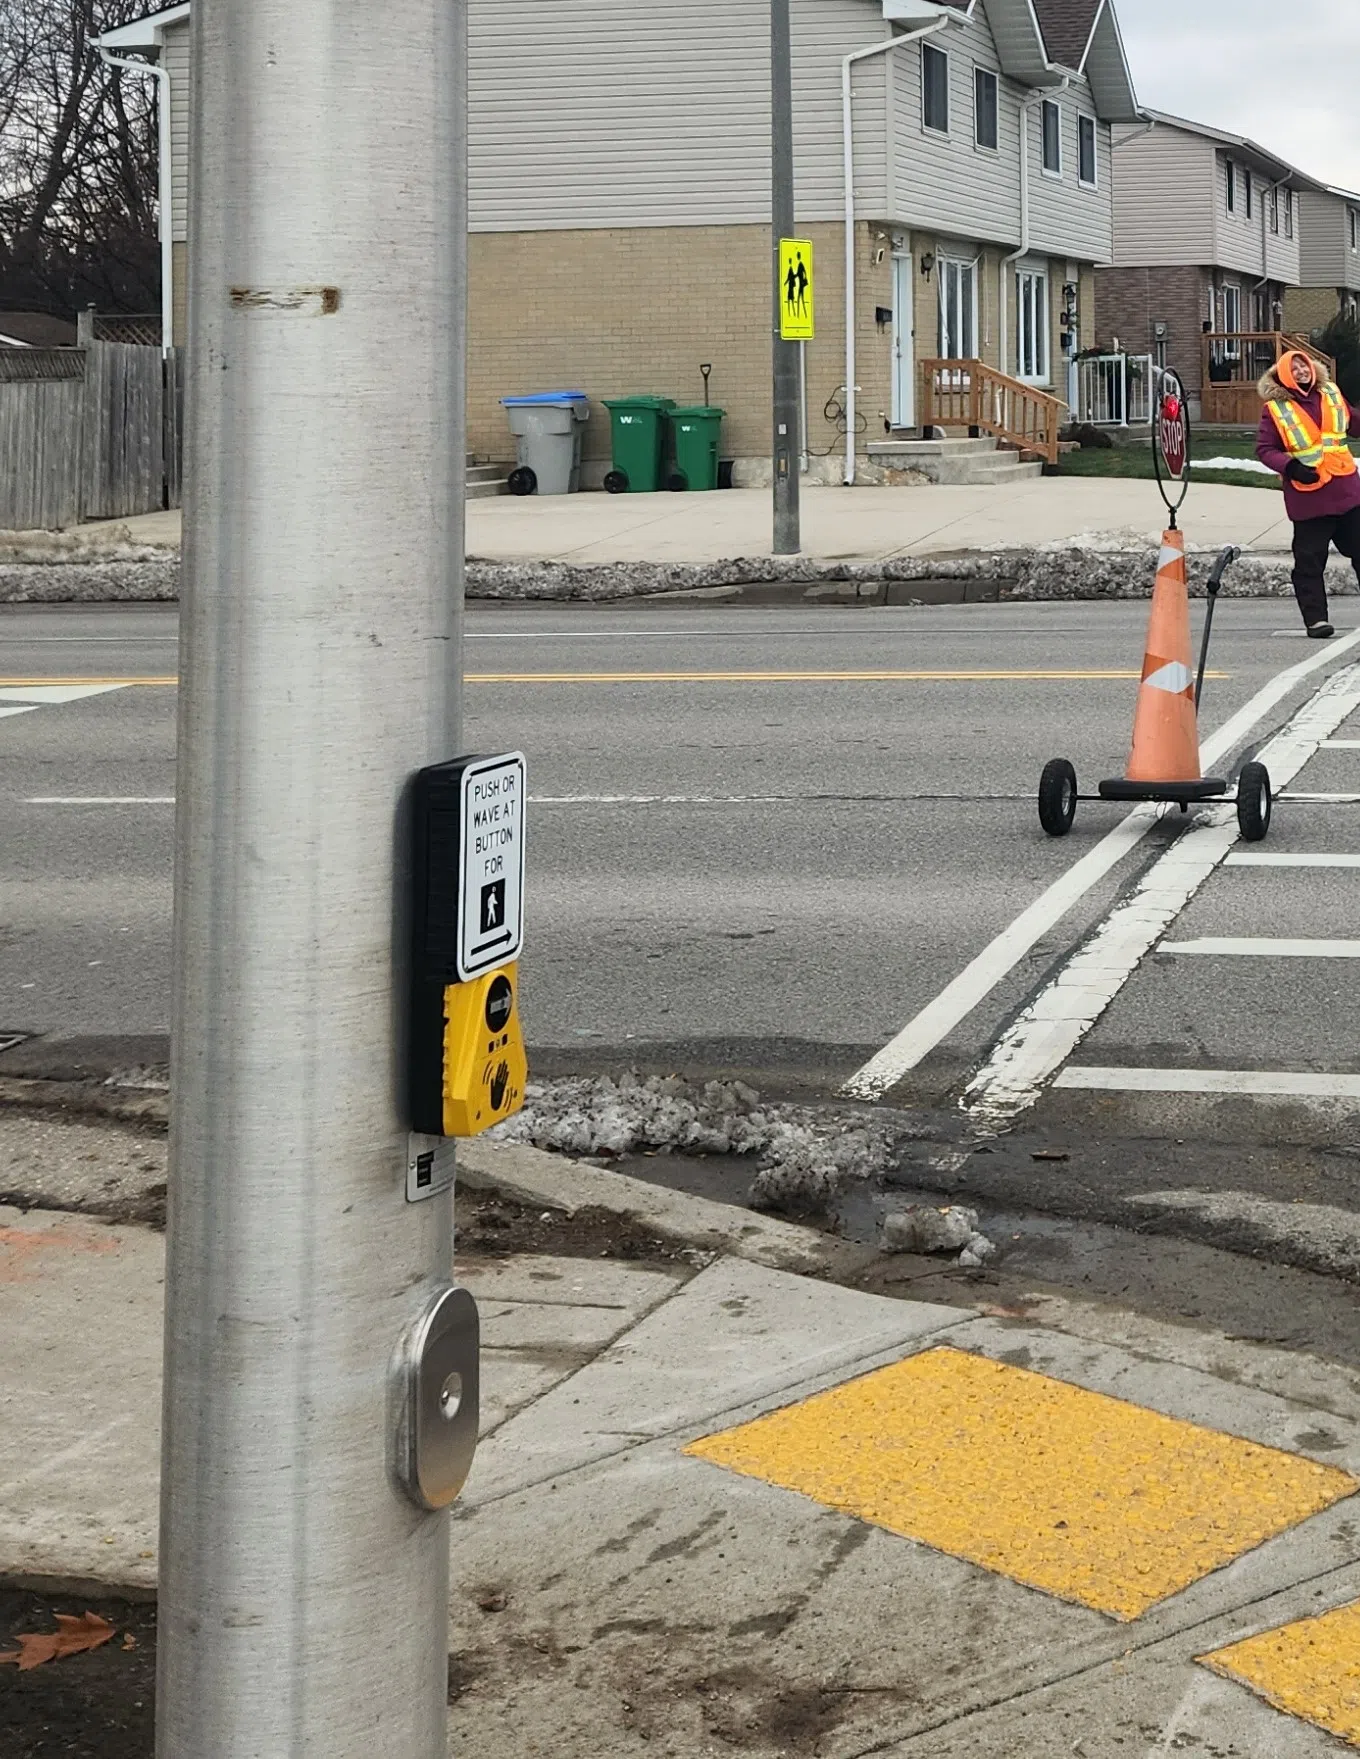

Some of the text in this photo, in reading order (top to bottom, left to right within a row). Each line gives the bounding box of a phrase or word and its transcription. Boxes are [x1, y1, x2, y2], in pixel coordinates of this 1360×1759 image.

[1162, 418, 1182, 456] STOP
[475, 775, 515, 802] PUSH OR
[474, 800, 515, 828] WAVE AT
[475, 826, 513, 854] BUTTON
[485, 855, 503, 877] FOR
